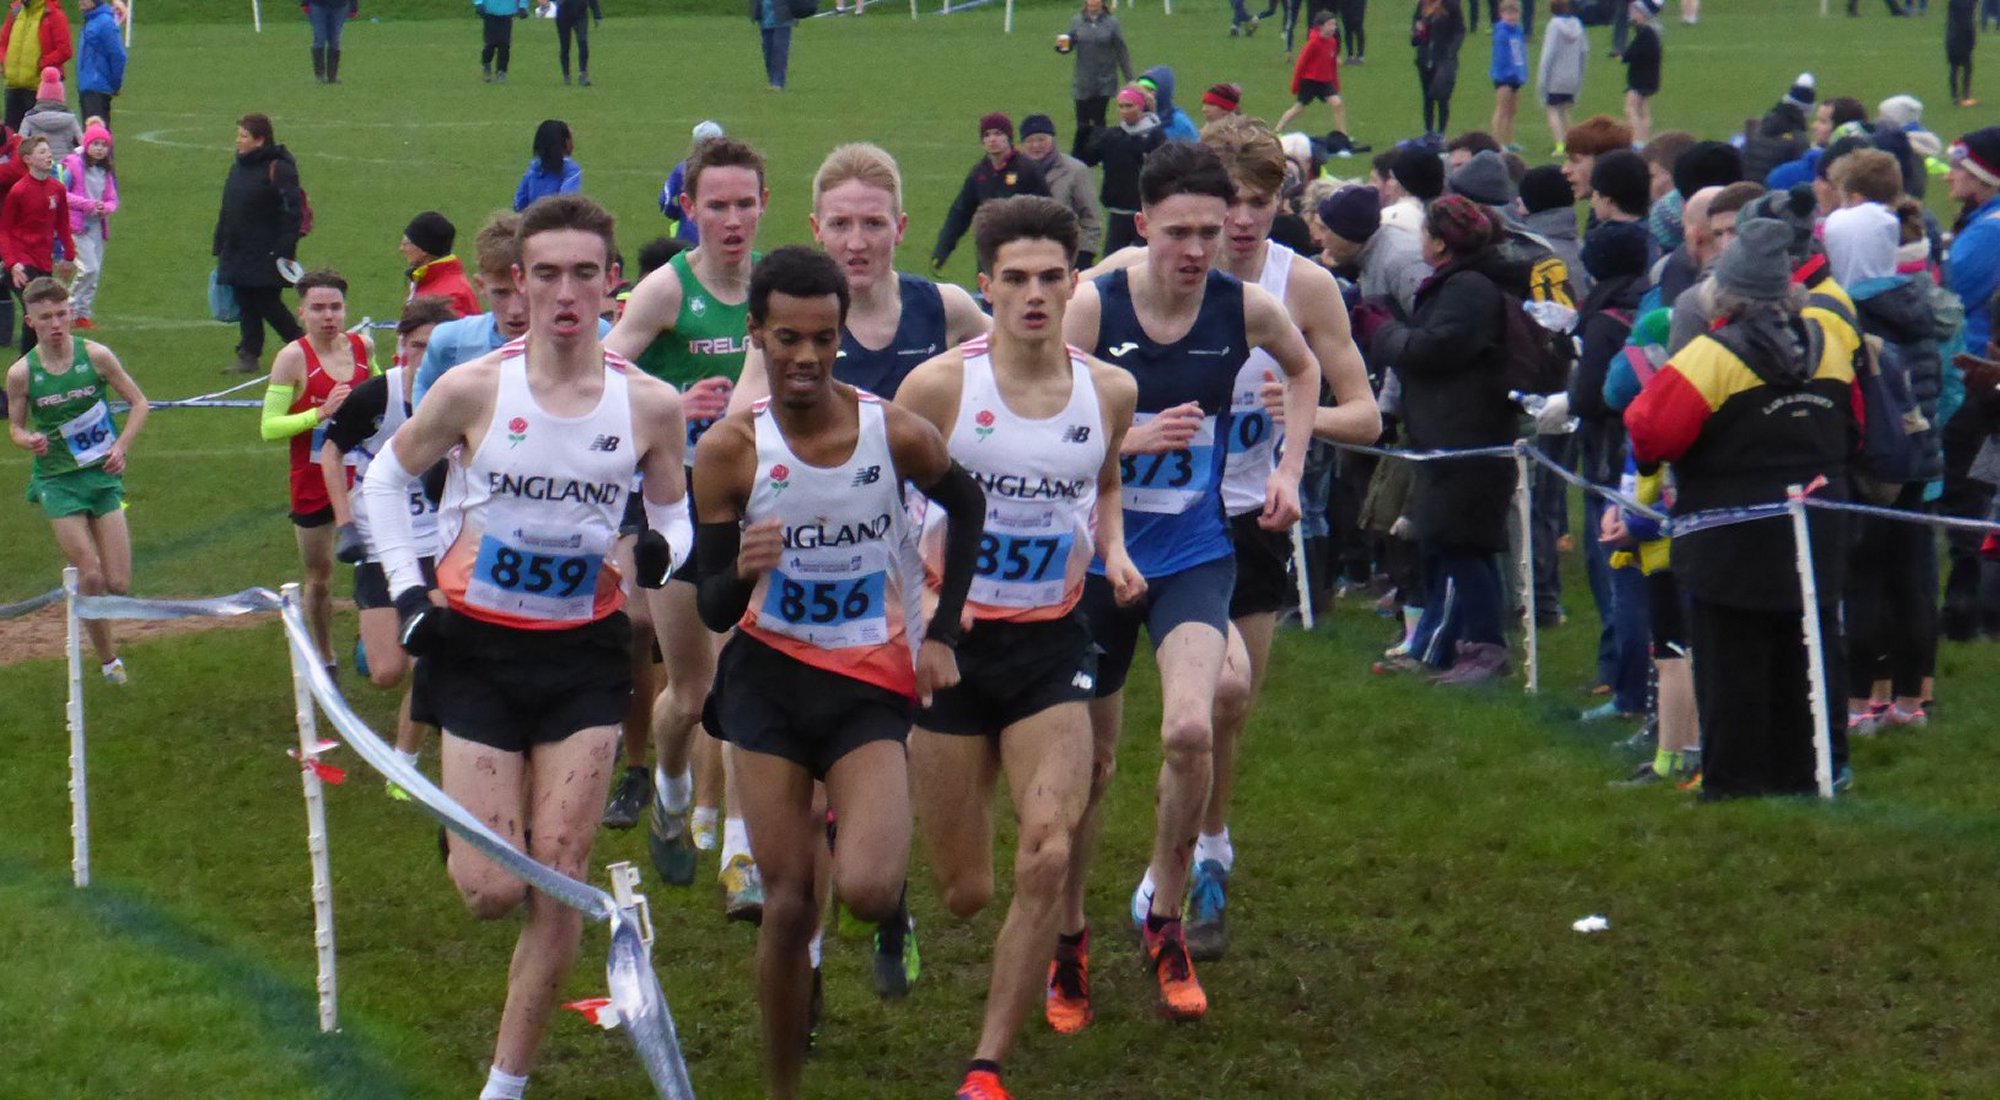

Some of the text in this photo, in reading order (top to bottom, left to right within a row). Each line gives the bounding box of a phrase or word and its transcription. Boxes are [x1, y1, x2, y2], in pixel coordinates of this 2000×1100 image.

[37, 385, 96, 407] IRELAND
[74, 424, 109, 451] 86
[489, 471, 620, 505] ENGLAND
[967, 470, 1085, 499] NGLAND
[490, 546, 588, 597] 859
[975, 533, 1058, 581] 857
[780, 578, 870, 624] 856
